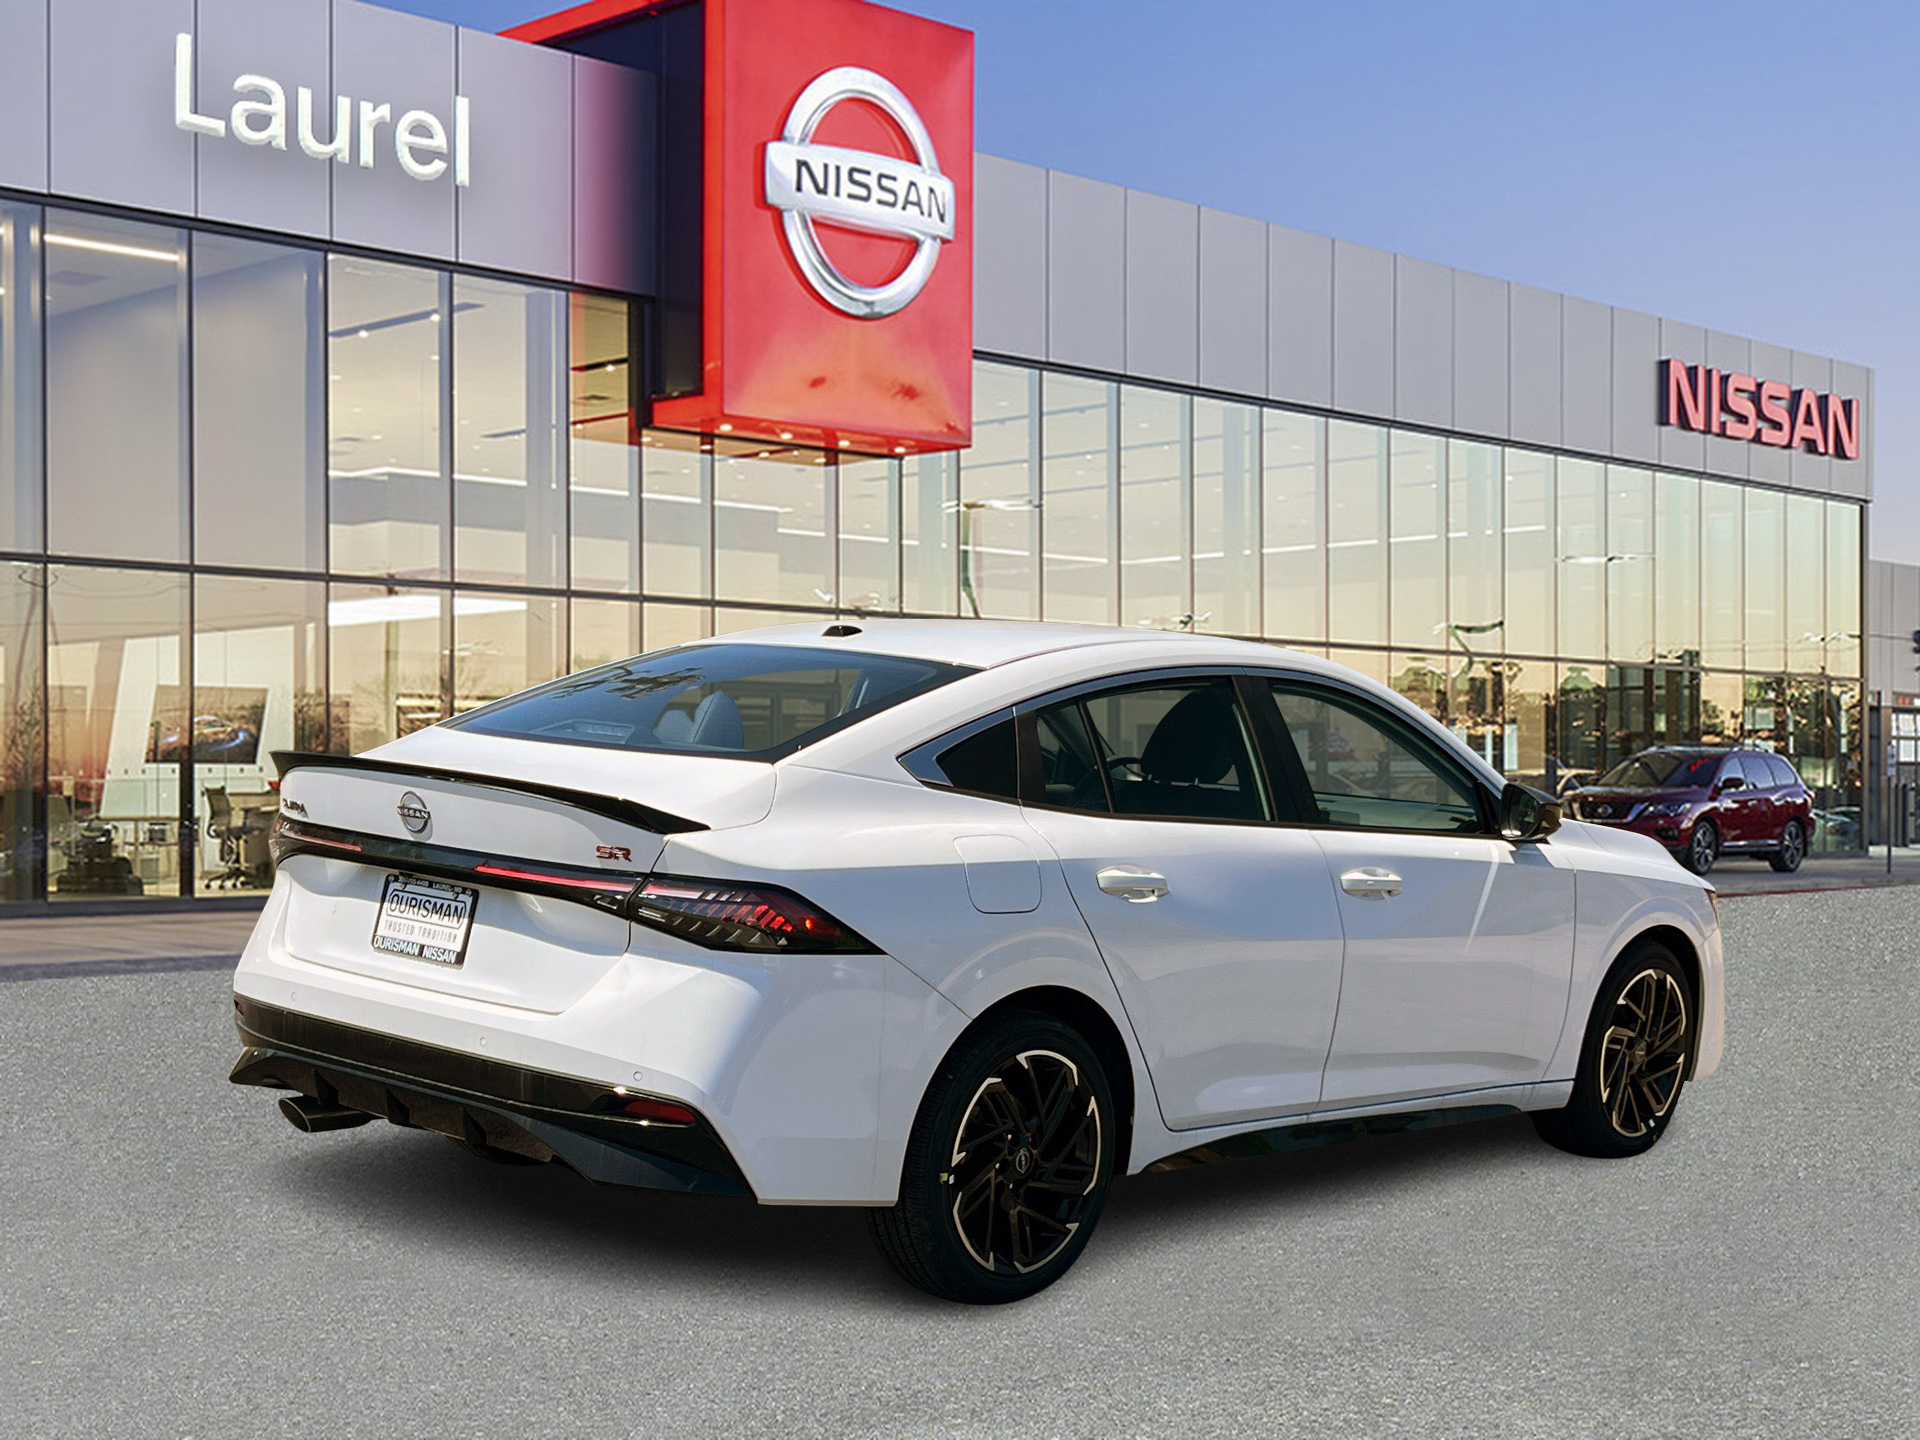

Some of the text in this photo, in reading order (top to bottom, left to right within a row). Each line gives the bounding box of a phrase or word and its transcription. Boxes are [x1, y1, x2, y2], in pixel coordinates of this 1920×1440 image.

[175, 33, 470, 187] Laurel
[795, 158, 946, 224] NISSAN
[1658, 358, 1860, 460] NISSAN
[595, 845, 632, 862] SR
[389, 893, 464, 925] OURISMAN
[384, 919, 457, 944] TRUSTED TRADITION
[373, 935, 457, 964] OURISMAN NISSAN
